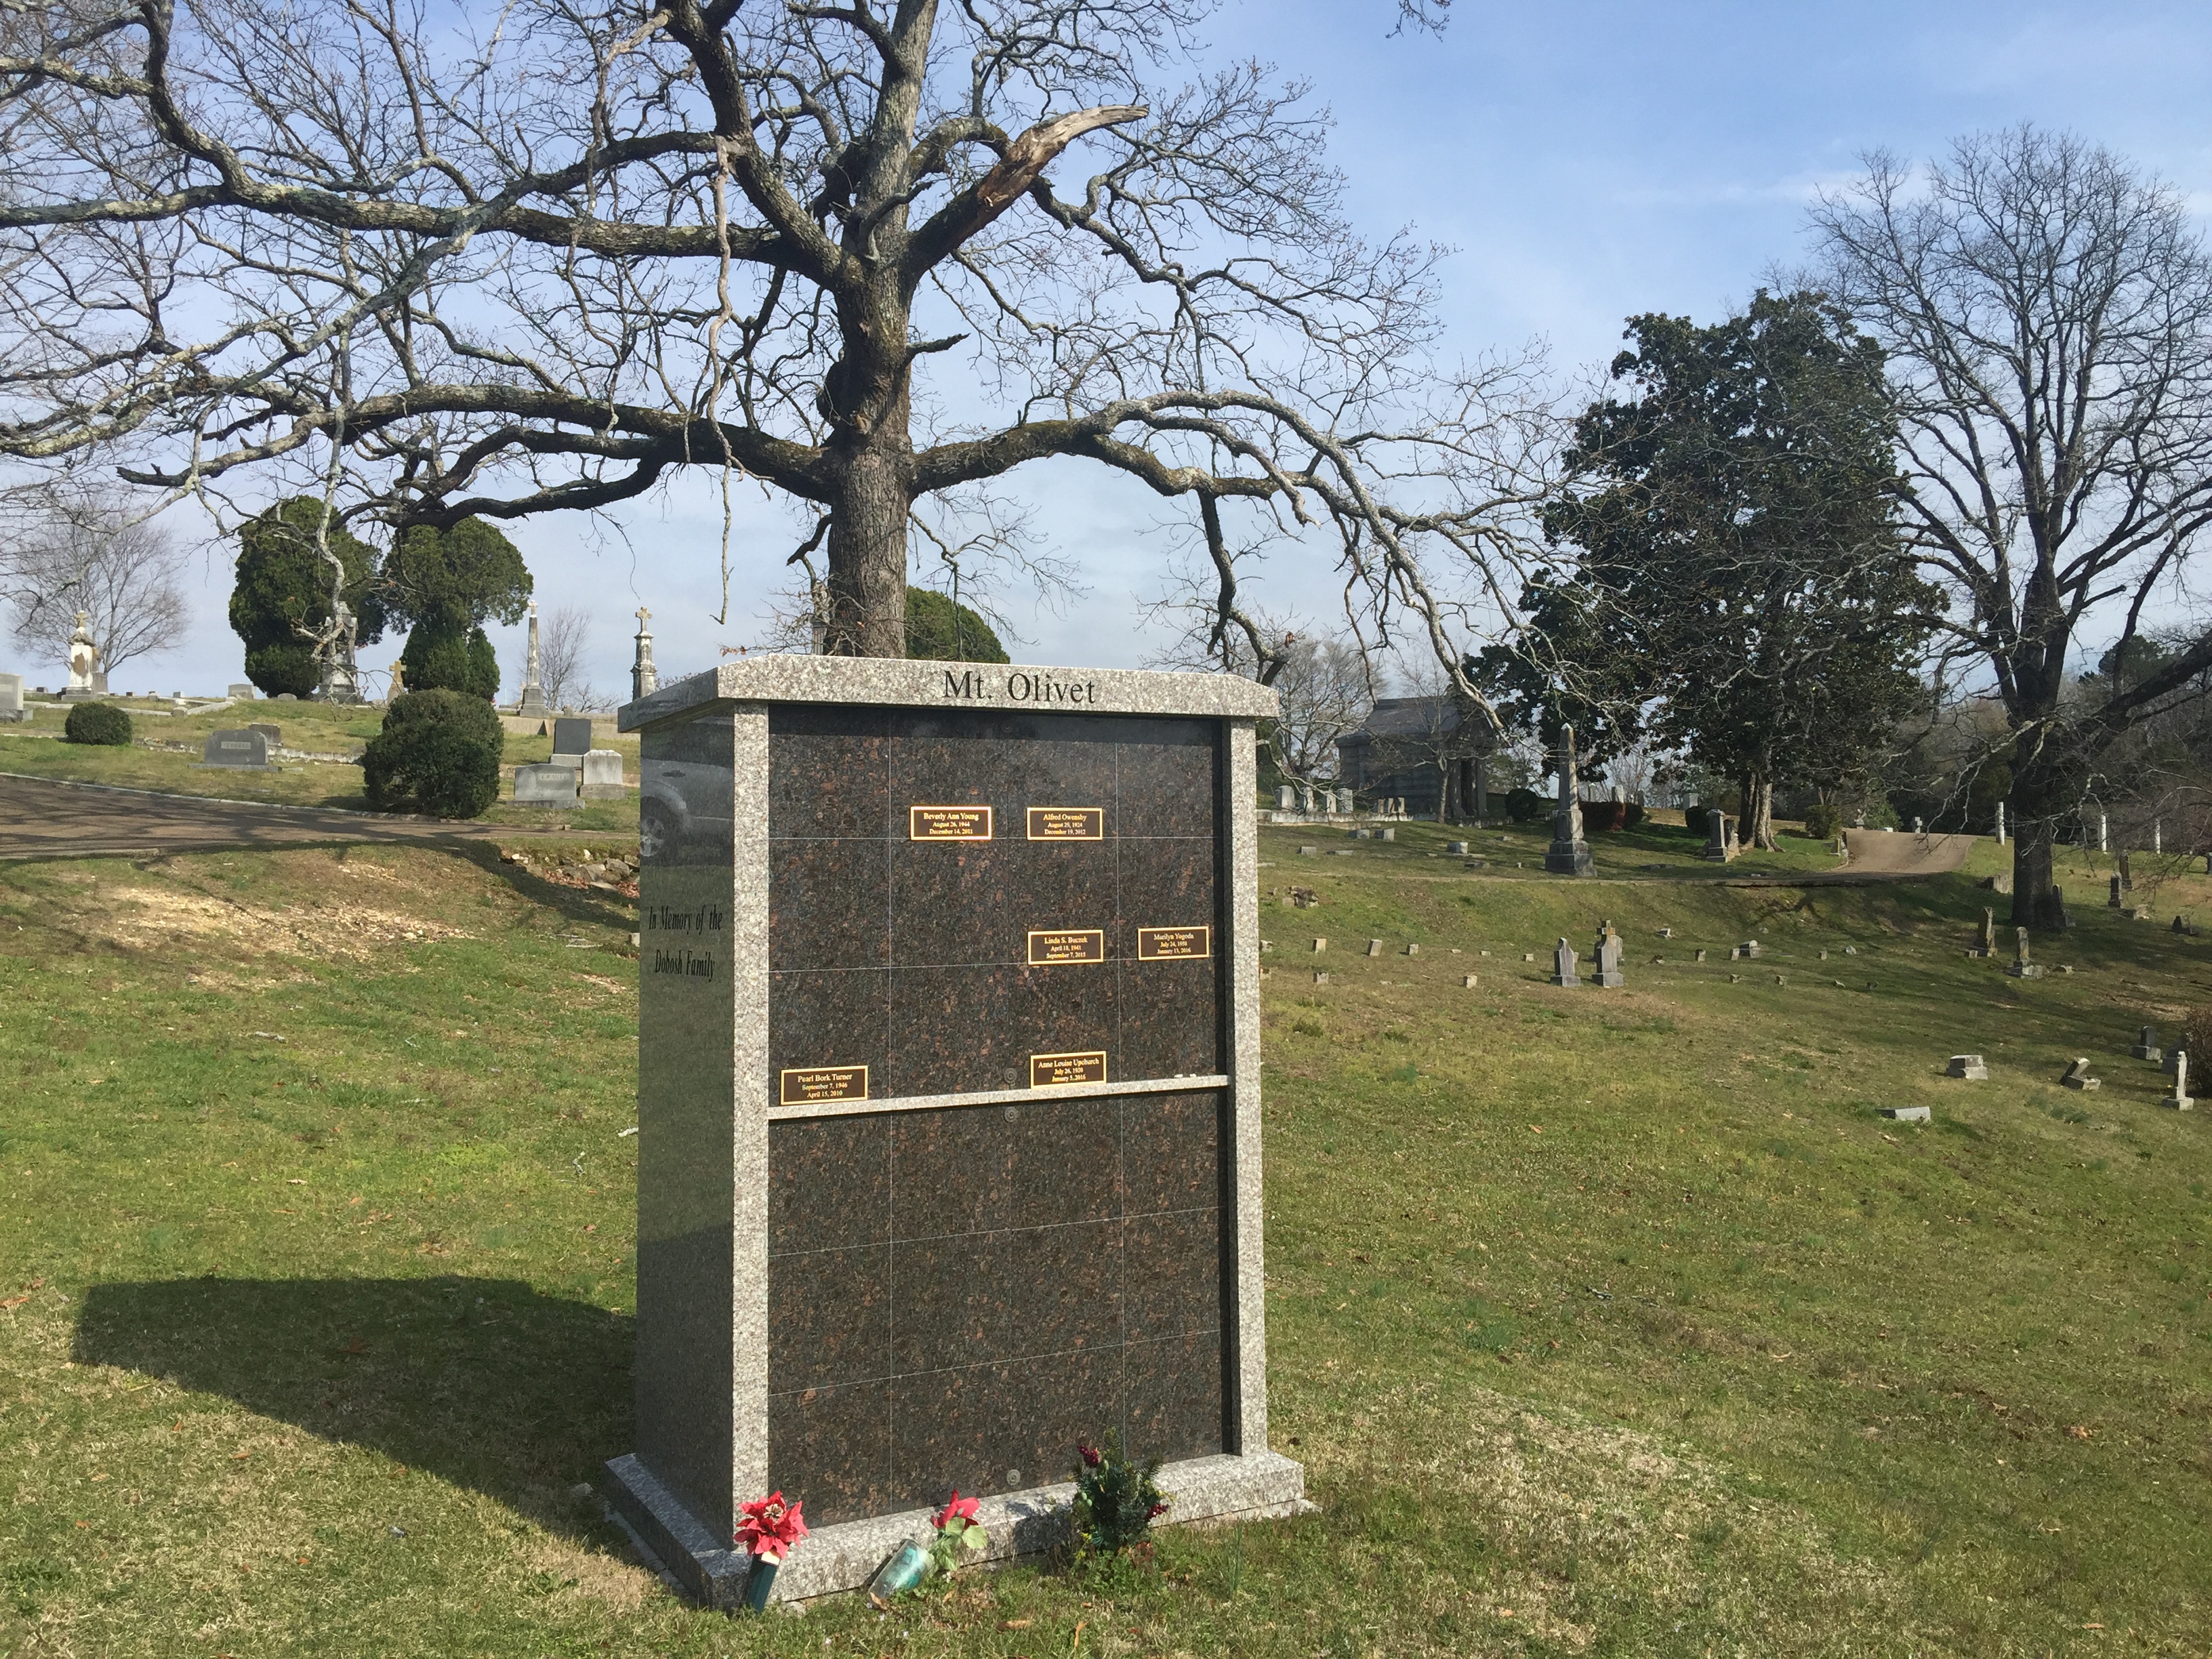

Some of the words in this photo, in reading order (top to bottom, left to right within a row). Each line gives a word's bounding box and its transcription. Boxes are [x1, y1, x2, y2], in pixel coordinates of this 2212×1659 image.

[943, 670, 992, 700] Mt.
[1008, 673, 1097, 704] Olivet
[924, 813, 946, 821] Beverly
[960, 813, 979, 821] Young
[1062, 814, 1087, 822] Owensby
[649, 906, 657, 930] In
[659, 905, 693, 935] Memory
[696, 905, 706, 936] of
[709, 904, 722, 930] the
[1153, 933, 1174, 941] Marilyn
[655, 949, 682, 975] Dobosh
[686, 950, 715, 983] Family
[1073, 1058, 1099, 1067] Upchurch
